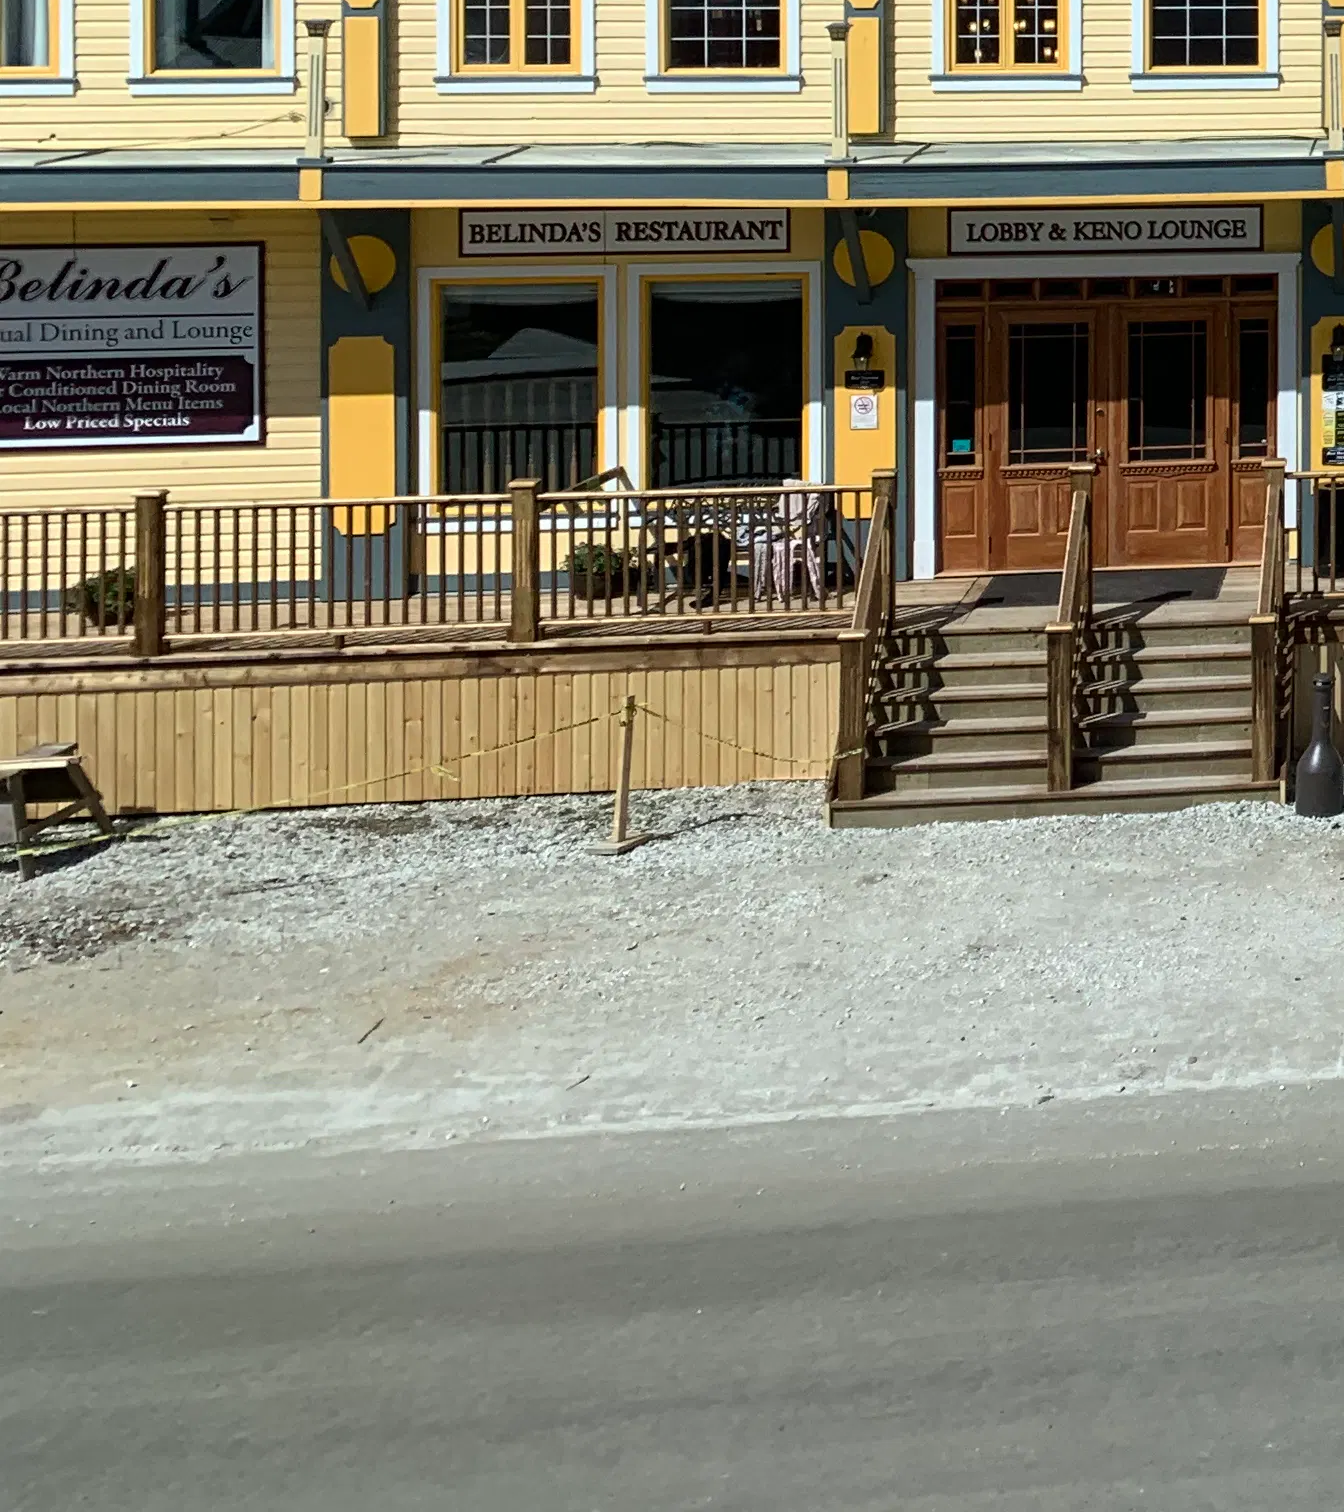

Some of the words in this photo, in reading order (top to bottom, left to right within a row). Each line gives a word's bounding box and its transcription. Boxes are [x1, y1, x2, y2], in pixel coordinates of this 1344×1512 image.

[468, 222, 602, 244] BELINDA'S
[615, 219, 784, 241] RESTAURANT
[966, 222, 1044, 242] LOBBY
[1048, 223, 1066, 241] &
[1073, 221, 1142, 240] KENO
[1147, 219, 1247, 239] LOUNGE
[0, 255, 254, 303] Belinda's
[0, 322, 32, 343] ual
[39, 322, 119, 347] Dining
[123, 319, 165, 340] and
[172, 320, 254, 345] Lounge
[46, 365, 125, 380] Northern
[130, 362, 224, 381] Hospitality
[8, 380, 117, 398] Conditioned
[122, 381, 181, 398] Dining
[185, 379, 236, 393] Room
[41, 397, 121, 413] Northern
[125, 396, 173, 411] Menu
[178, 396, 224, 410] Items
[23, 416, 62, 430] Low
[65, 413, 119, 429] Priced
[123, 412, 191, 432] Specials
